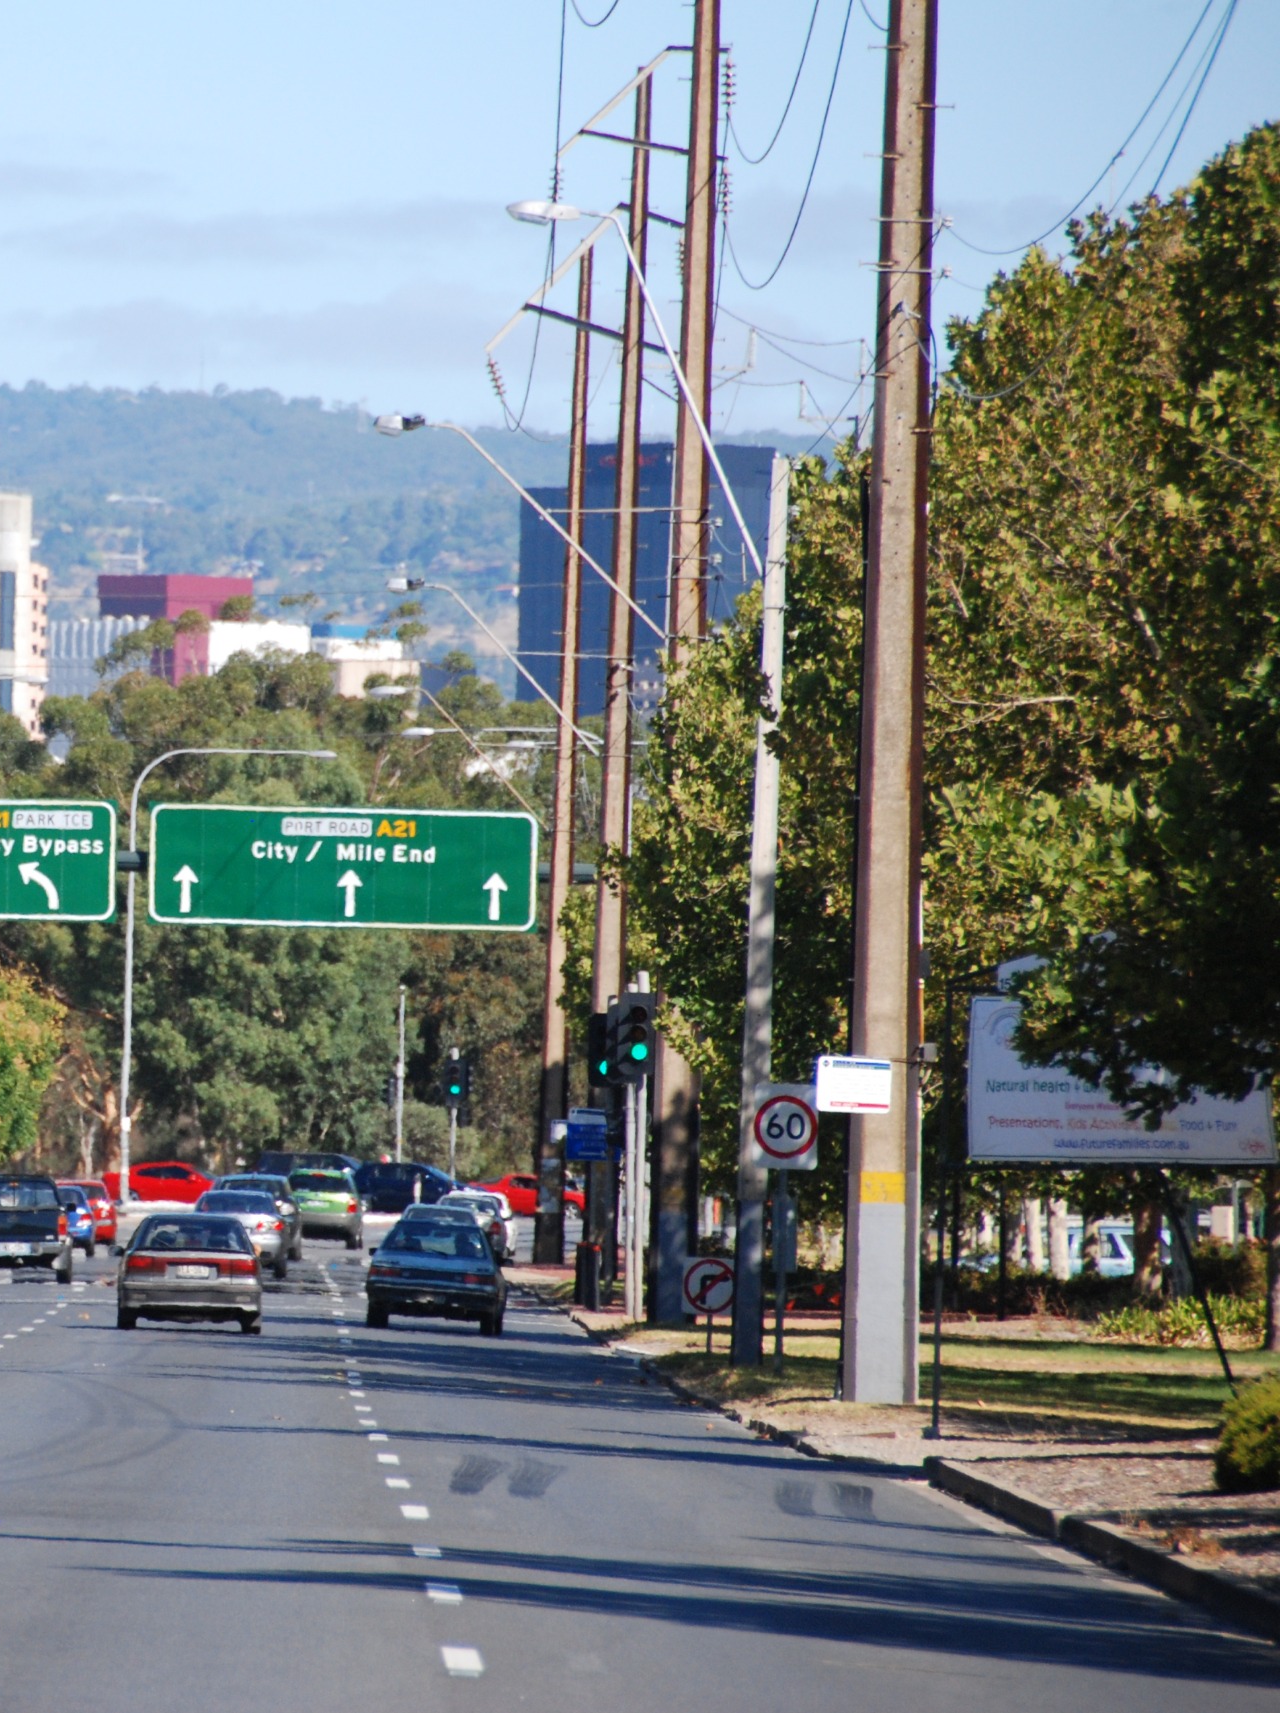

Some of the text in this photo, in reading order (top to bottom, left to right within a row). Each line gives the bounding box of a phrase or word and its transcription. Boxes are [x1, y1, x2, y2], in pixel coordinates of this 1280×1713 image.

[15, 813, 56, 826] PARK
[64, 814, 91, 827] TCE
[284, 819, 416, 837] PORT ROAD A21
[23, 834, 104, 857] Bypass
[251, 840, 299, 863] City
[336, 843, 386, 862] Mile
[392, 844, 436, 863] End
[986, 1079, 1029, 1093] Natural
[1033, 1080, 1070, 1093] health
[766, 1112, 806, 1140] 60
[1180, 1120, 1204, 1132] Food
